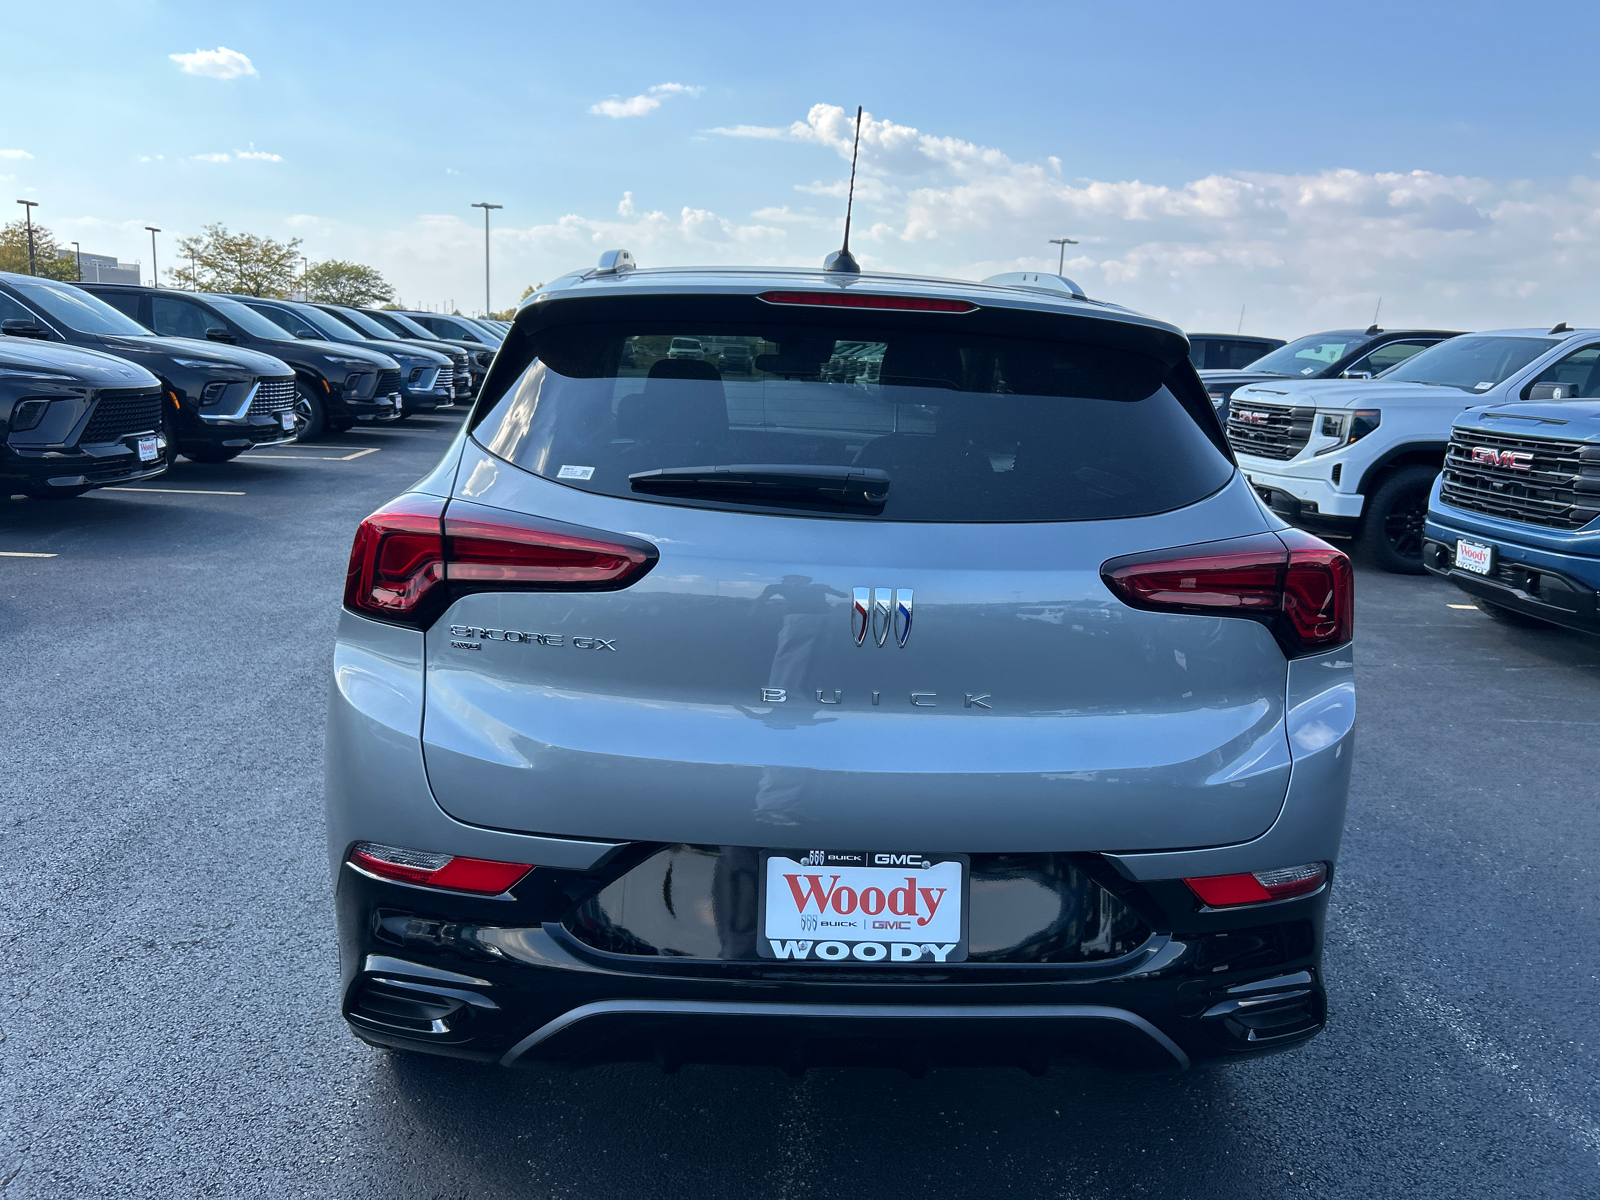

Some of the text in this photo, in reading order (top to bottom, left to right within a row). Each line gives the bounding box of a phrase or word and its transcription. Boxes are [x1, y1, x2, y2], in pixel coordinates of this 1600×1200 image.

[1472, 446, 1534, 470] GMC
[1460, 544, 1488, 564] Woody
[1455, 560, 1488, 575] WOODY
[450, 624, 617, 652] ENCORE GX
[451, 639, 482, 651] AWD
[760, 687, 993, 709] BUICK
[874, 854, 922, 866] GMC
[783, 874, 947, 927] Woody
[872, 920, 911, 930] GMC
[769, 940, 957, 962] WOODY
